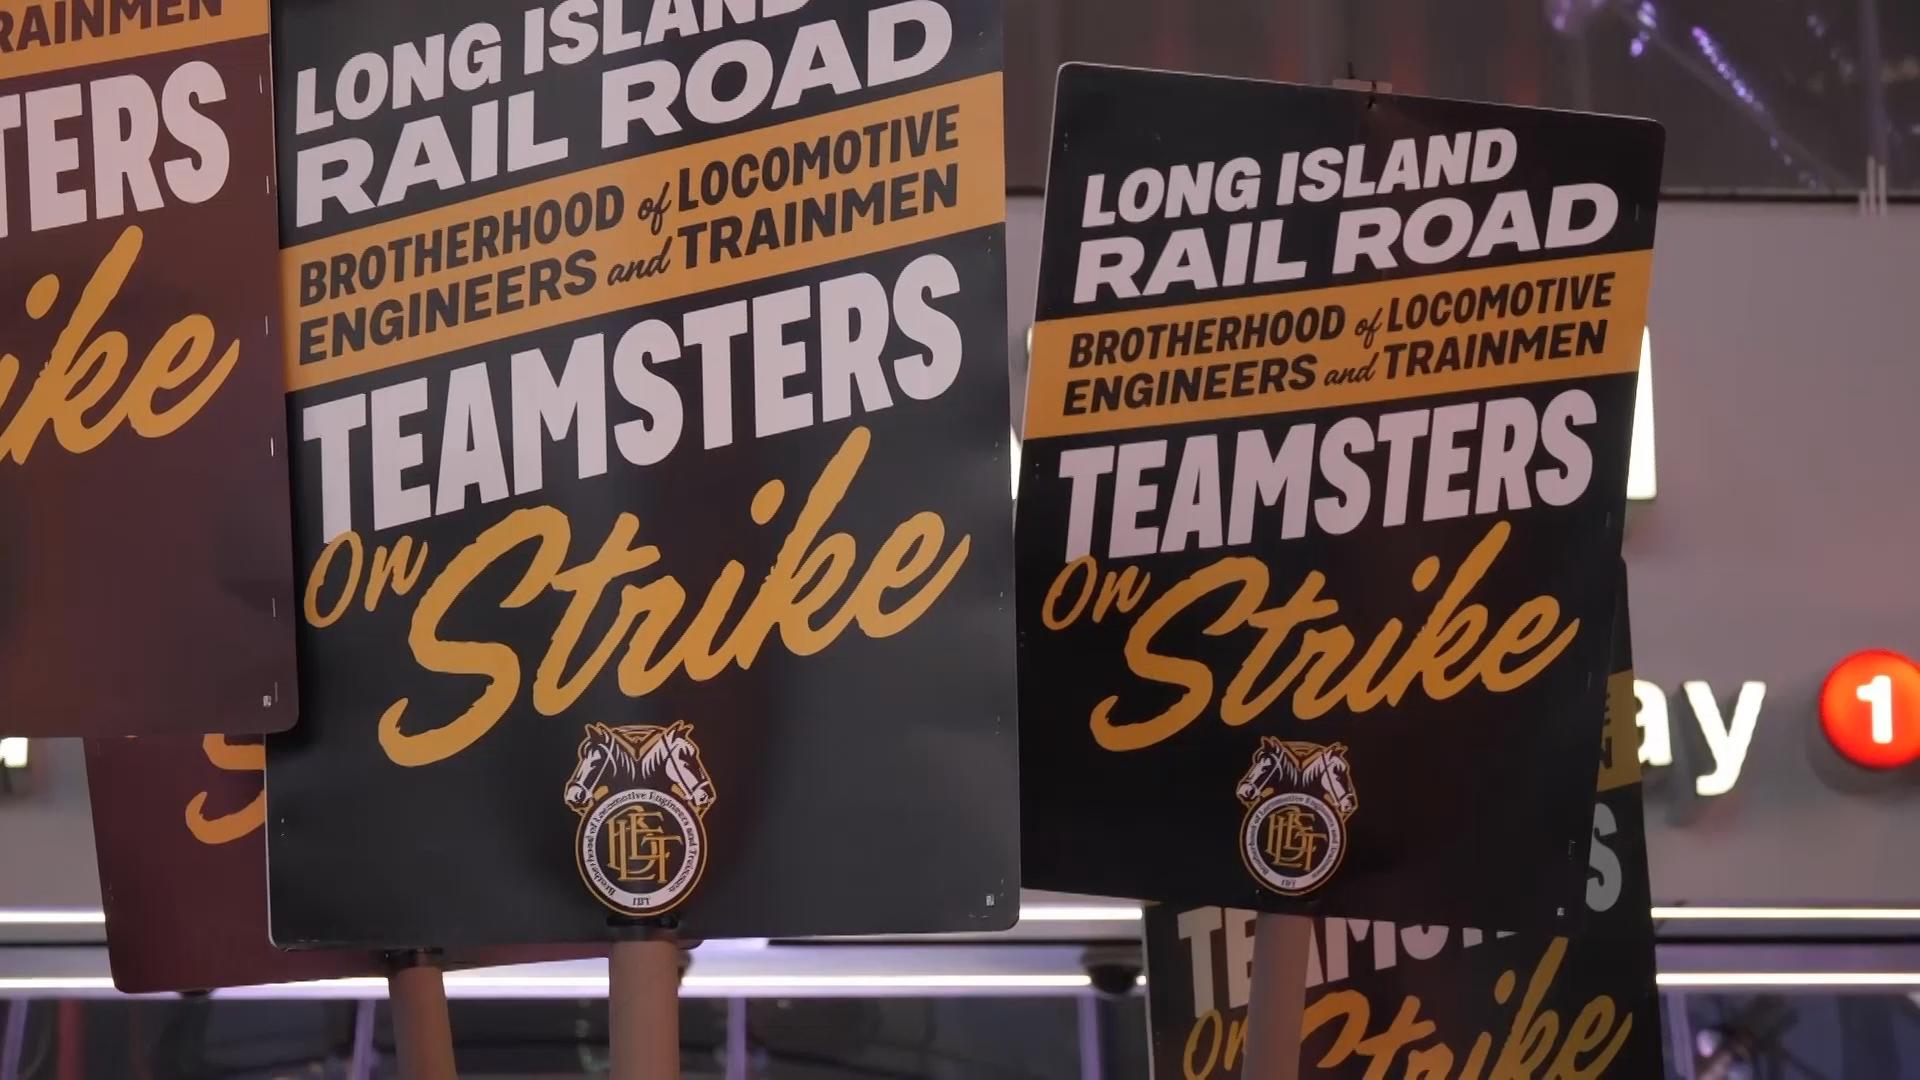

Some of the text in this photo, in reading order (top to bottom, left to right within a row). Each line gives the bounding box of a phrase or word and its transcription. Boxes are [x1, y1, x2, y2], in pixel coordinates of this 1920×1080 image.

[296, 0, 812, 135] LONG ISLA
[296, 0, 953, 228] RAIL ROAD
[300, 104, 960, 307] BROTHERHOOD of LOCOMOTIVE
[1073, 183, 1619, 303] RAIL ROAD
[1082, 128, 1517, 228] LONG ISLAND
[300, 163, 959, 365] ENGINEERS and TRAINMEN
[1069, 272, 1615, 369] BROTHERHOOD of LOCOMOTIVE
[303, 253, 962, 544] TEAMSTERS
[1063, 320, 1608, 416] ENGINEERS and TRAINMEN
[1059, 389, 1598, 562] TEAMSTERS
[305, 426, 971, 767] On Strike
[1041, 556, 1151, 630] On
[1090, 520, 1580, 752] Strike
[1857, 674, 1893, 744] 1
